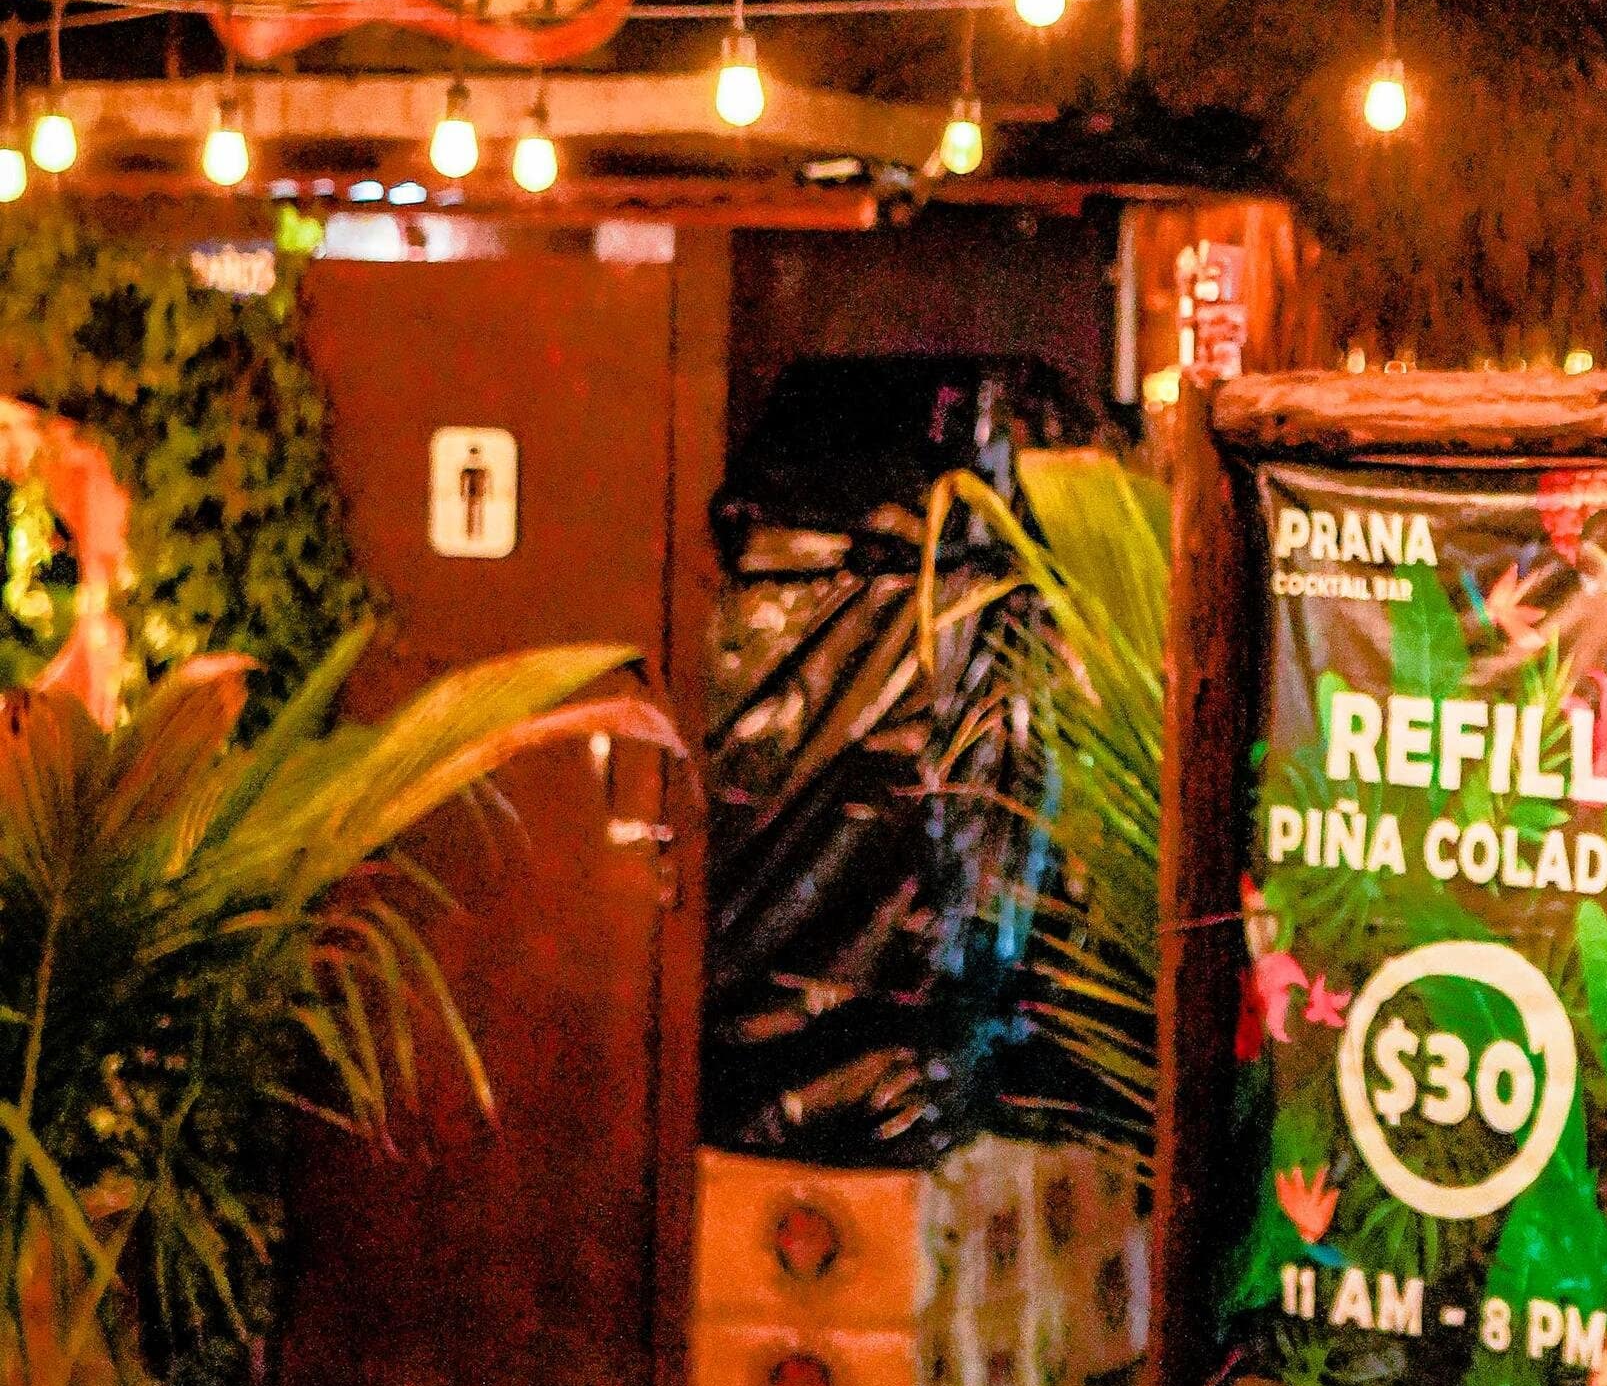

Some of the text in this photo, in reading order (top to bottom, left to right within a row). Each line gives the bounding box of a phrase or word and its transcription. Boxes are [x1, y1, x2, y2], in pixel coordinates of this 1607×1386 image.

[1273, 507, 1439, 566] PRANA
[1267, 798, 1407, 877] PIÑA
[1372, 1019, 1536, 1134] $30
[1280, 1264, 1317, 1318] 11
[1331, 1267, 1426, 1337] AM
[1479, 1296, 1512, 1352] 8
